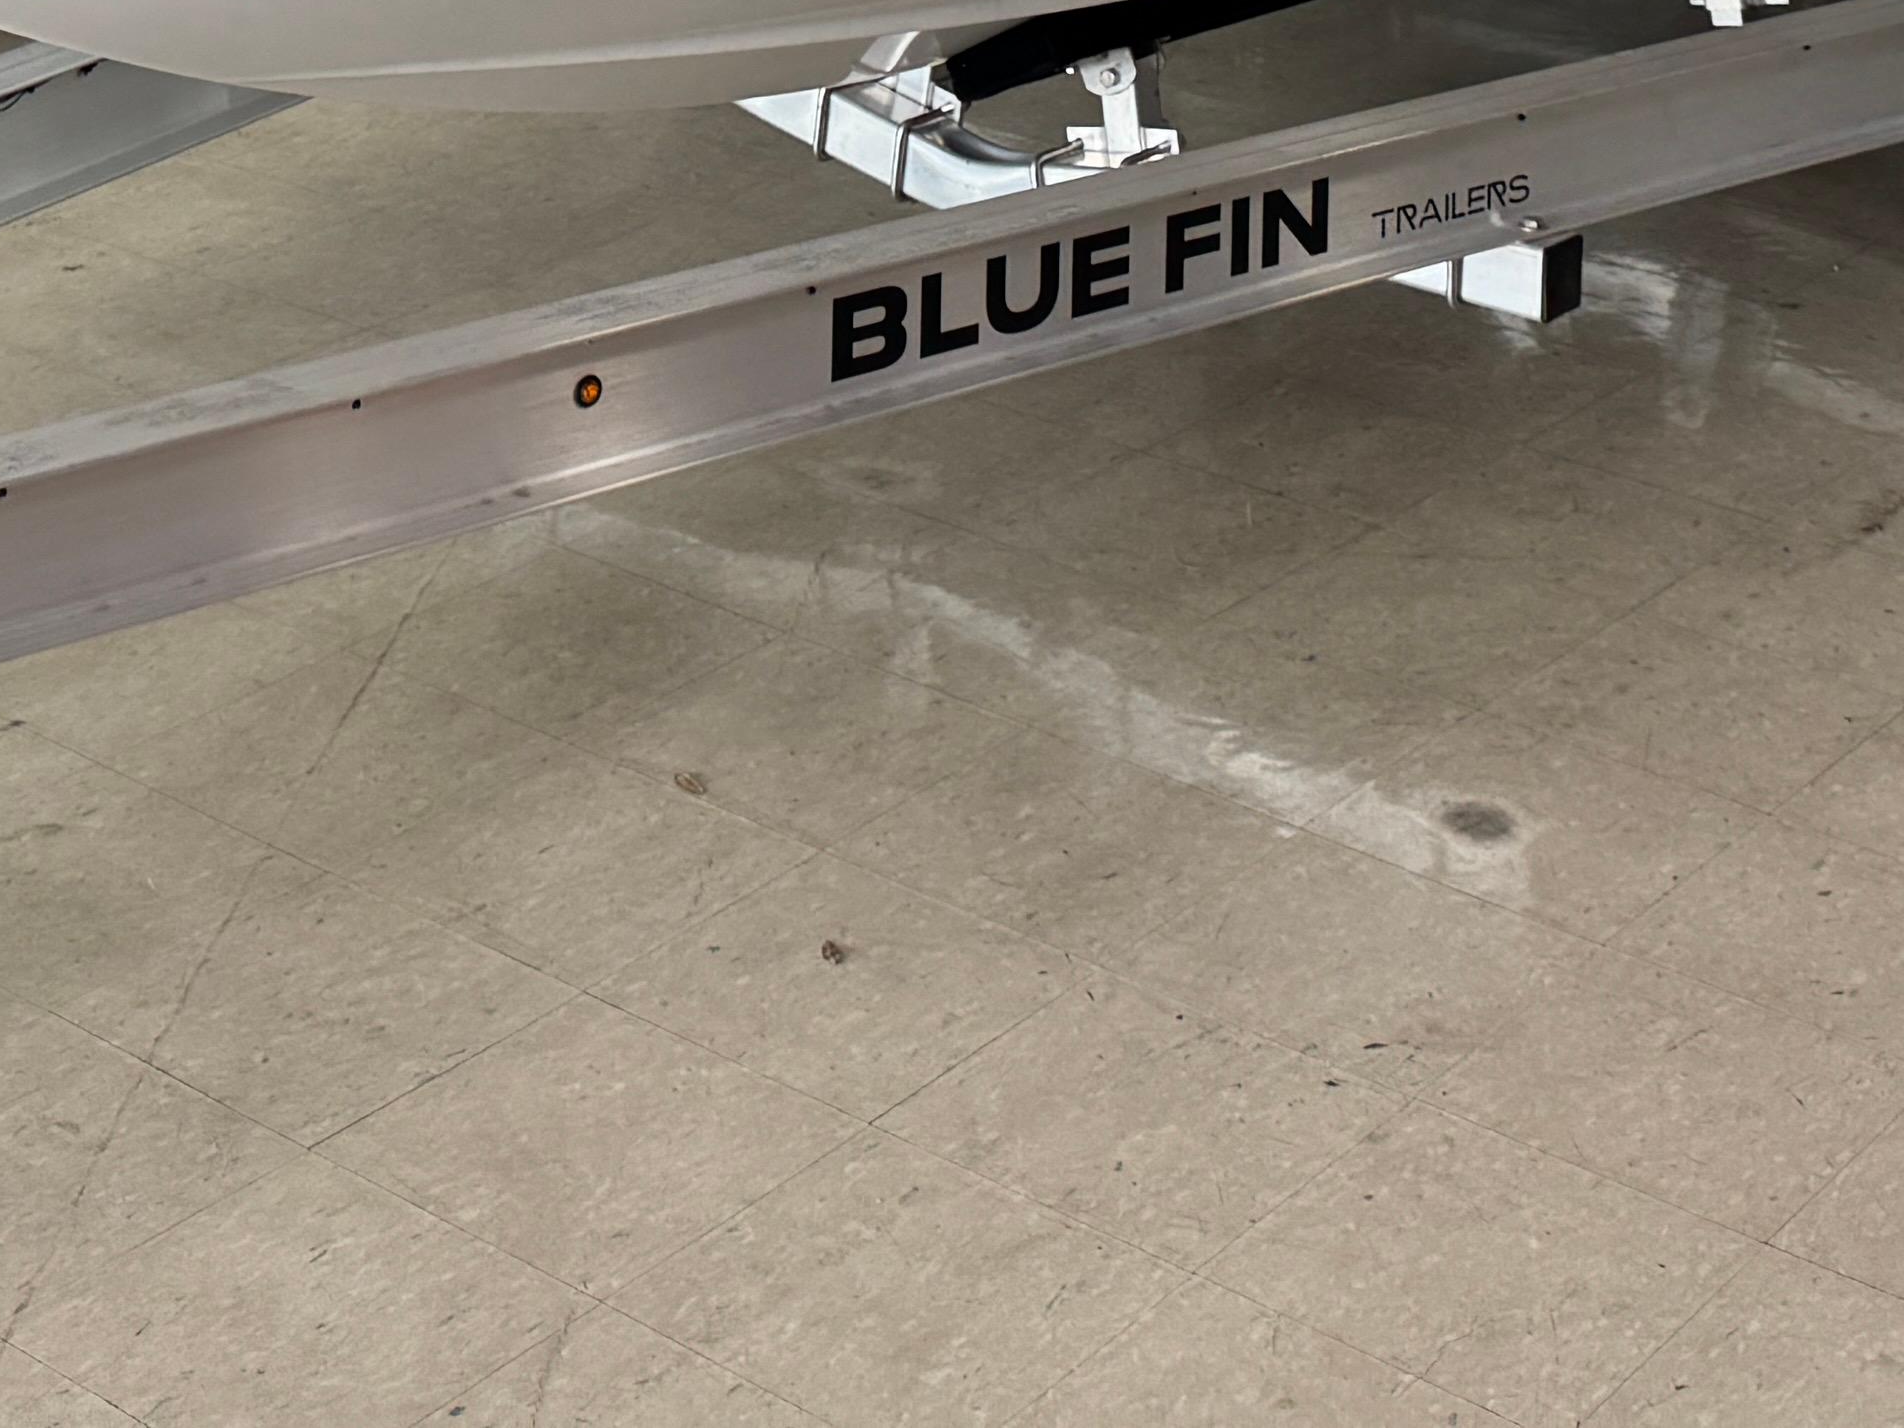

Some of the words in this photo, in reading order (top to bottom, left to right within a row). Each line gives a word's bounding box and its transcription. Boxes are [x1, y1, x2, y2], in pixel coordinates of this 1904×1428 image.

[830, 225, 1131, 383] BLUE
[1165, 177, 1330, 294] FIN
[1372, 173, 1532, 240] TRAILERS
